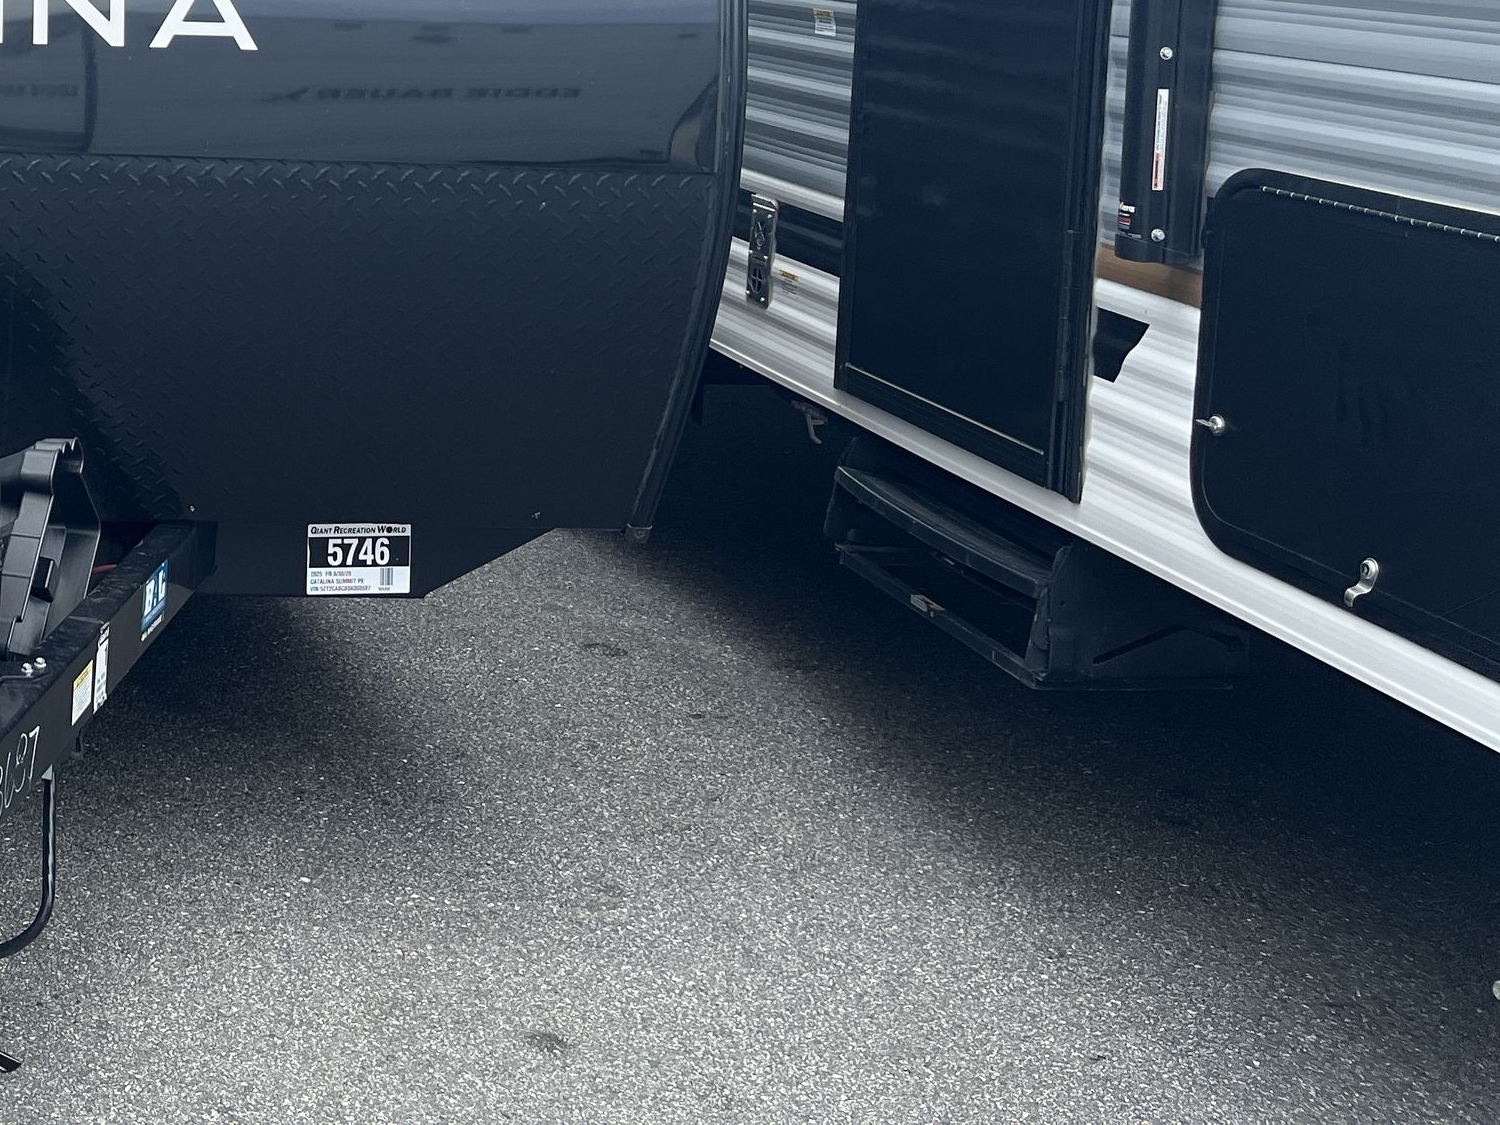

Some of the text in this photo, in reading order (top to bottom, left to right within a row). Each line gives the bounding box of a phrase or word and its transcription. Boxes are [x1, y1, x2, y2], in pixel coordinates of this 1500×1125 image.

[310, 524, 407, 535] GIANT RECREATION WORLD
[327, 537, 390, 566] 5746
